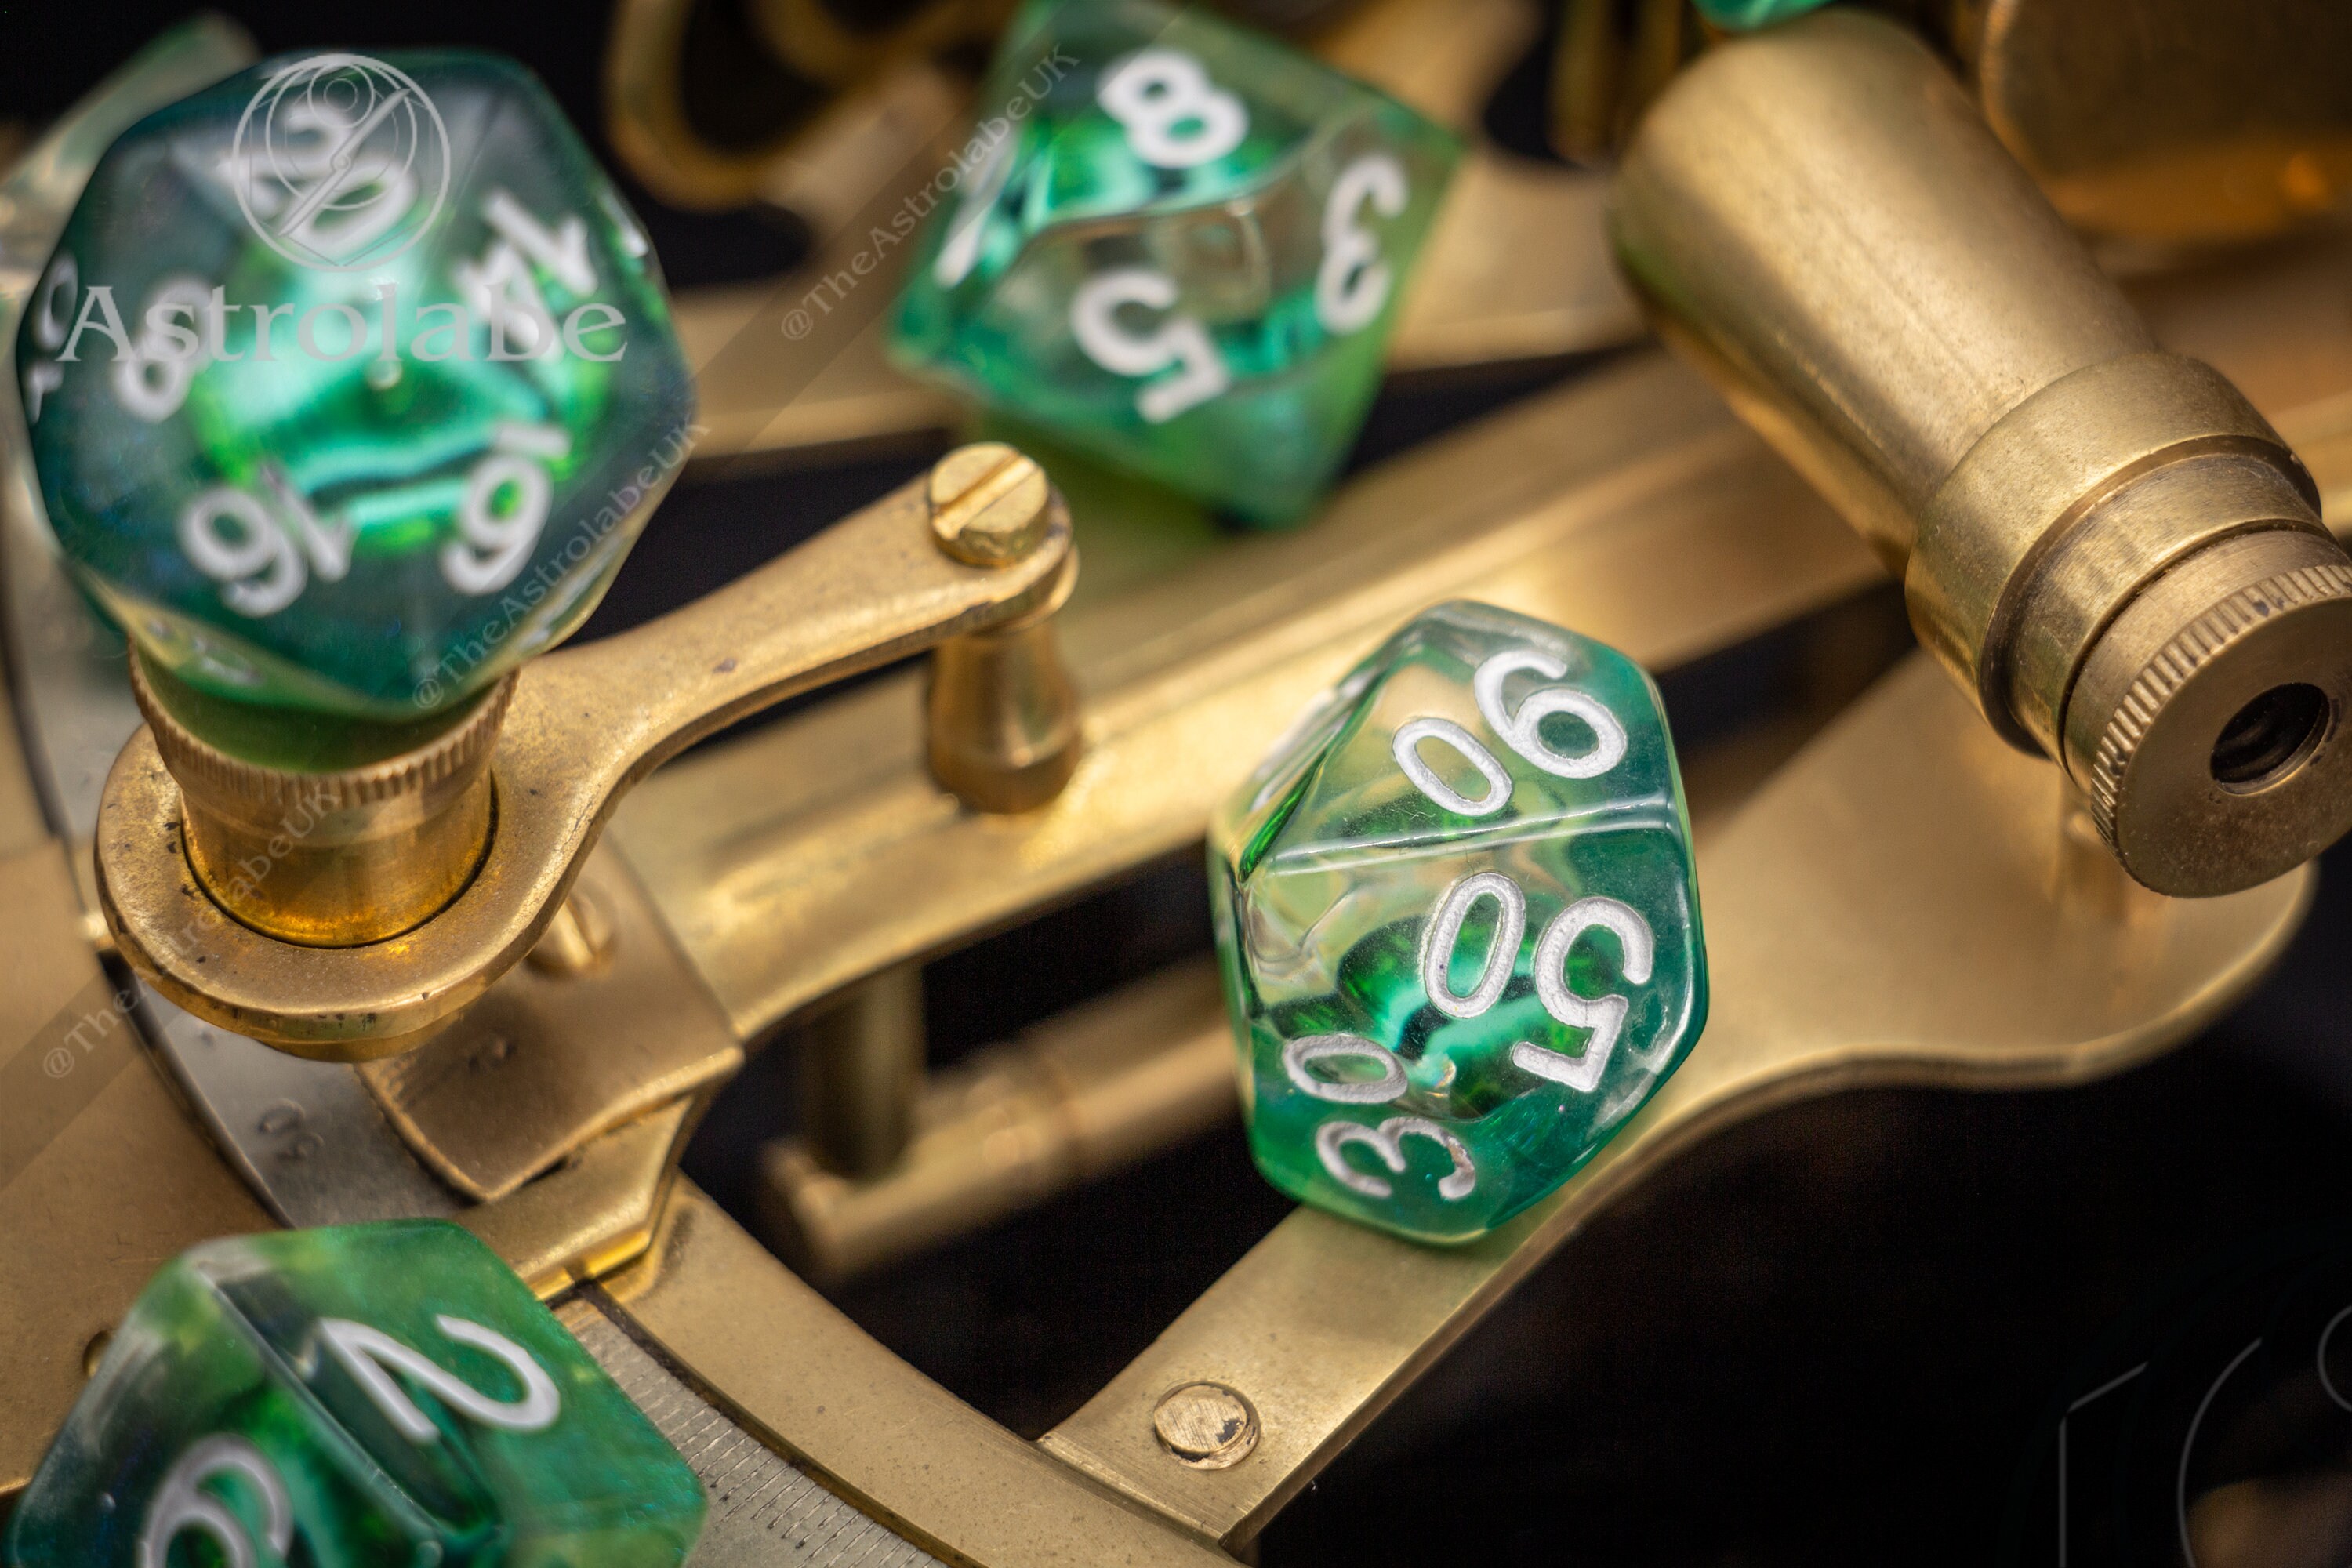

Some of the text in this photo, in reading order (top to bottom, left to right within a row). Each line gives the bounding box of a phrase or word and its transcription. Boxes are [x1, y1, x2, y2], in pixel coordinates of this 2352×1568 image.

[1098, 49, 1250, 168] 8
[1071, 270, 1229, 423] 5
[318, 1314, 561, 1444] 2
